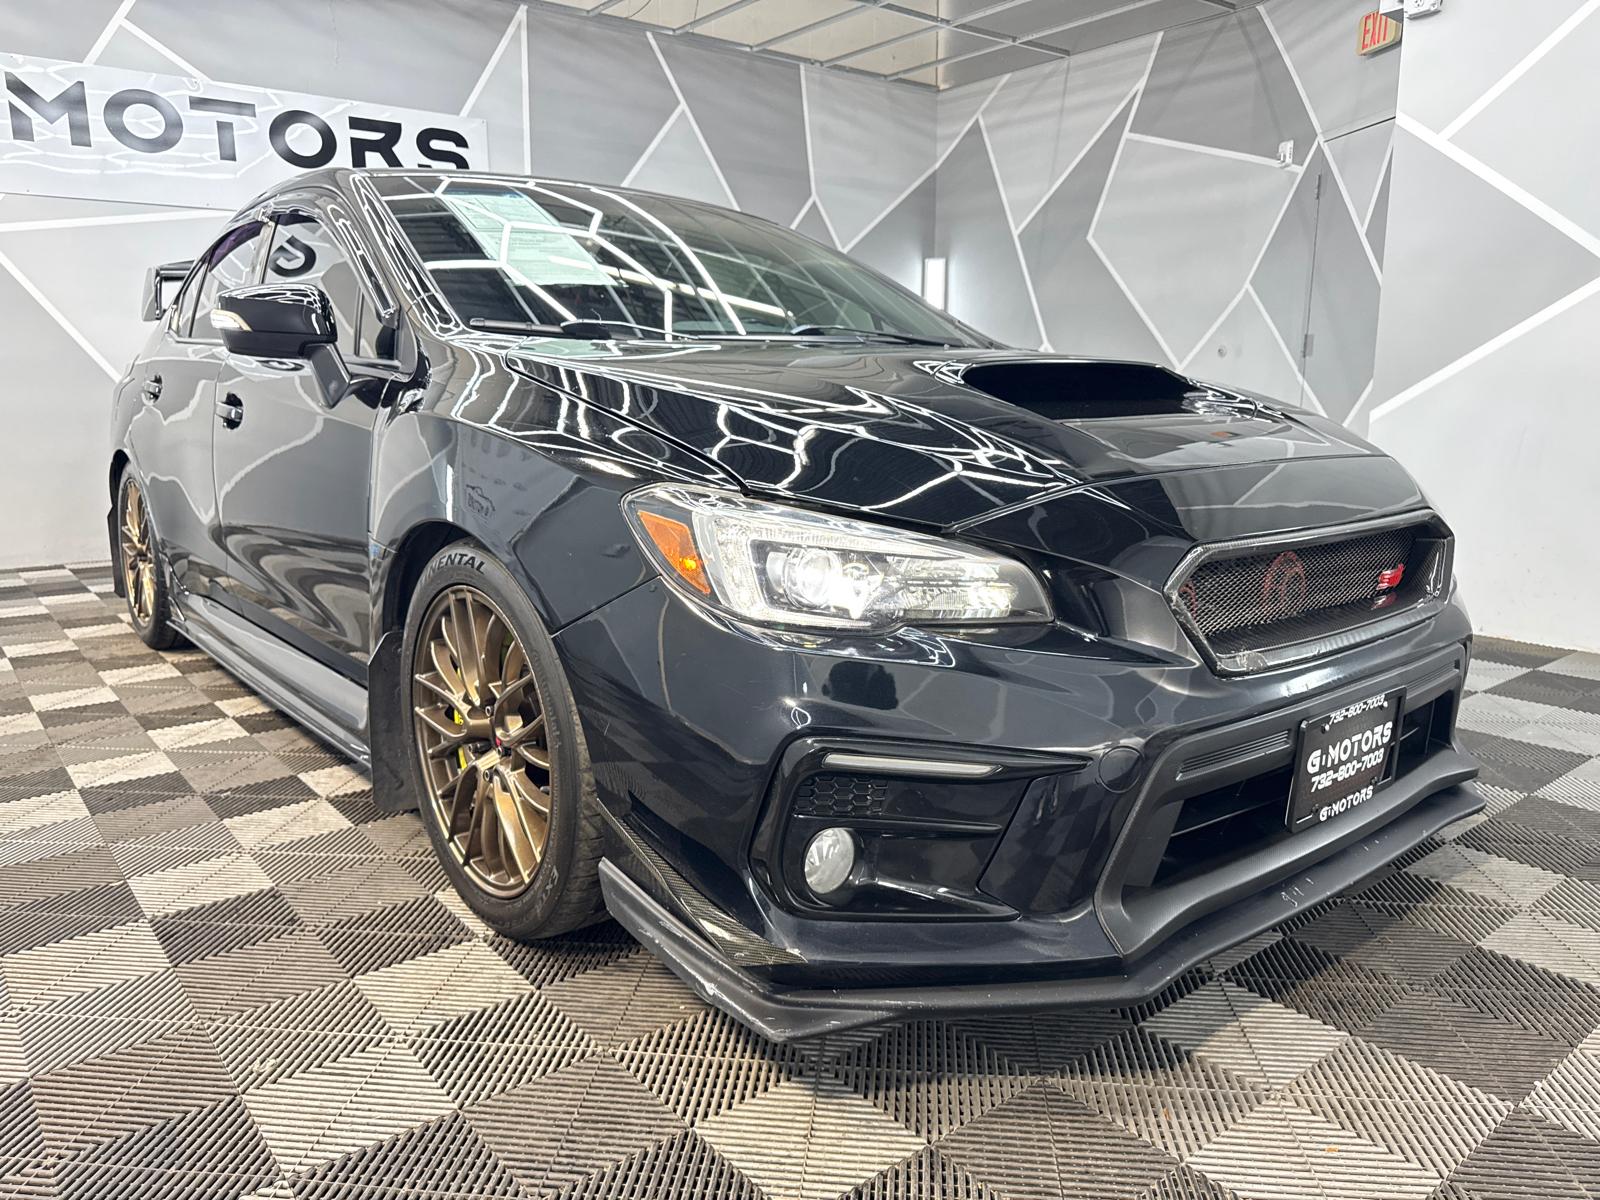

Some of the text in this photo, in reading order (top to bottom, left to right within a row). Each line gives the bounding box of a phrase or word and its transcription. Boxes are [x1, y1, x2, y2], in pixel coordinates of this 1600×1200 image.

[4, 71, 470, 170] MOTORS
[1329, 694, 1385, 725] 732-800-7003
[1311, 748, 1384, 793] 732-800-7003
